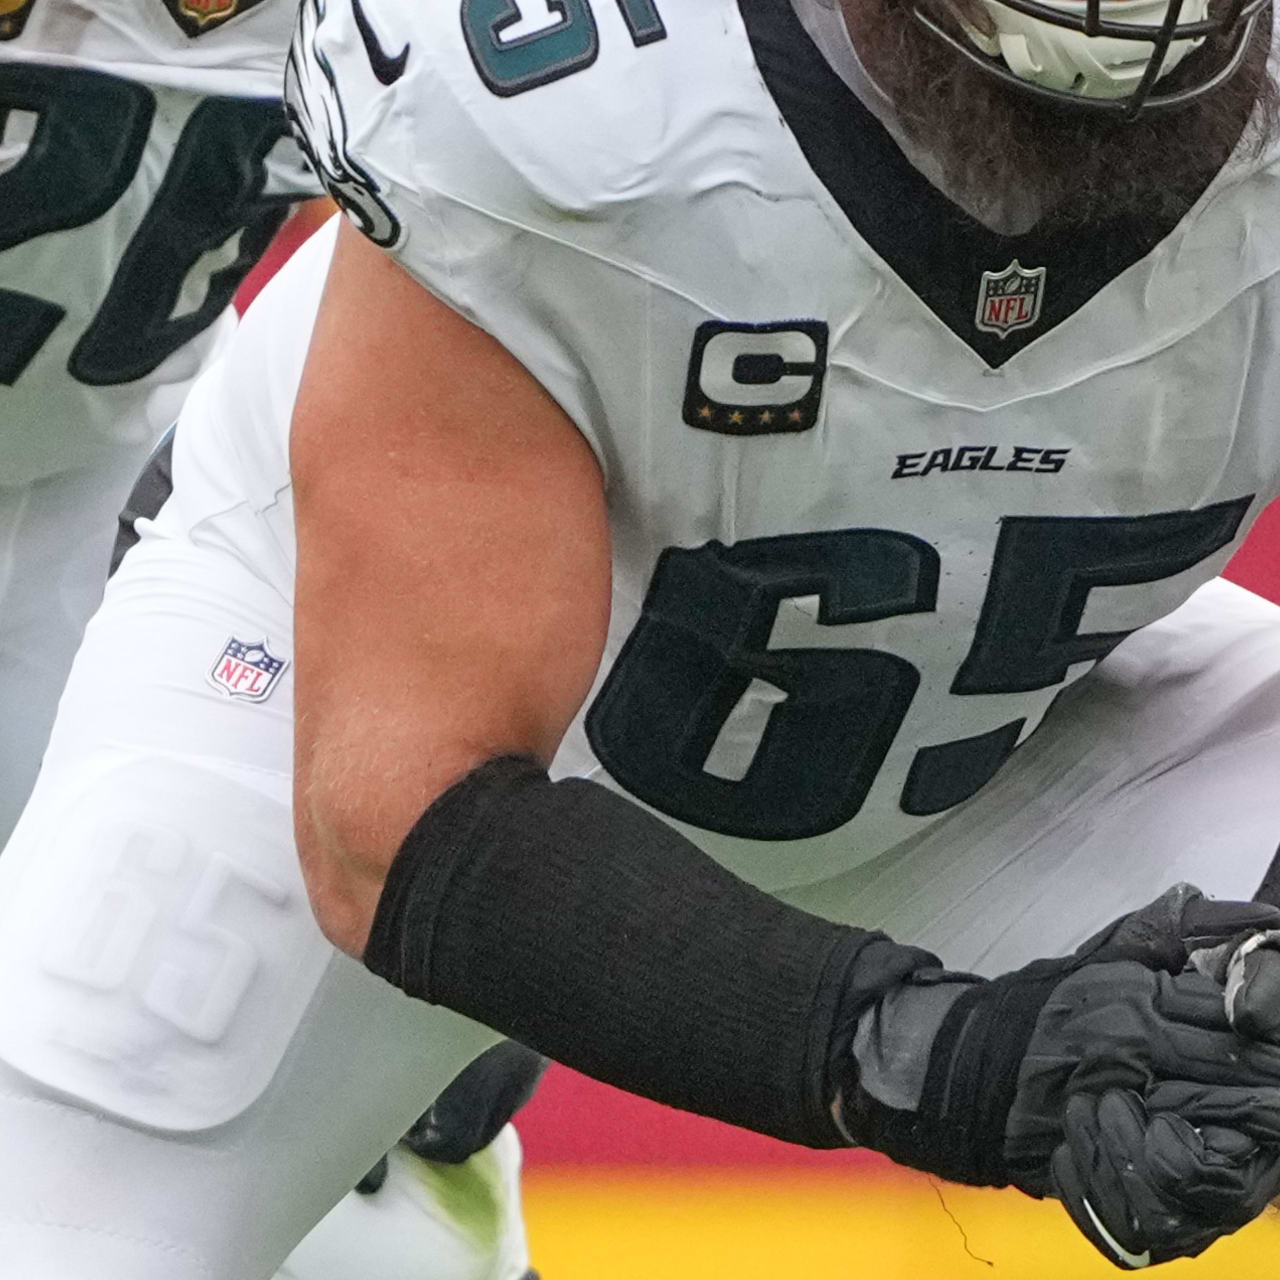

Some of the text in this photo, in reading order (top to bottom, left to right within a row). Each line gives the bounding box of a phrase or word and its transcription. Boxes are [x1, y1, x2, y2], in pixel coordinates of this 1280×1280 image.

[987, 297, 1029, 324] NFL
[699, 330, 816, 406] C
[891, 445, 1070, 479] EAGLES
[218, 658, 263, 692] NFL
[584, 493, 1256, 842] 65
